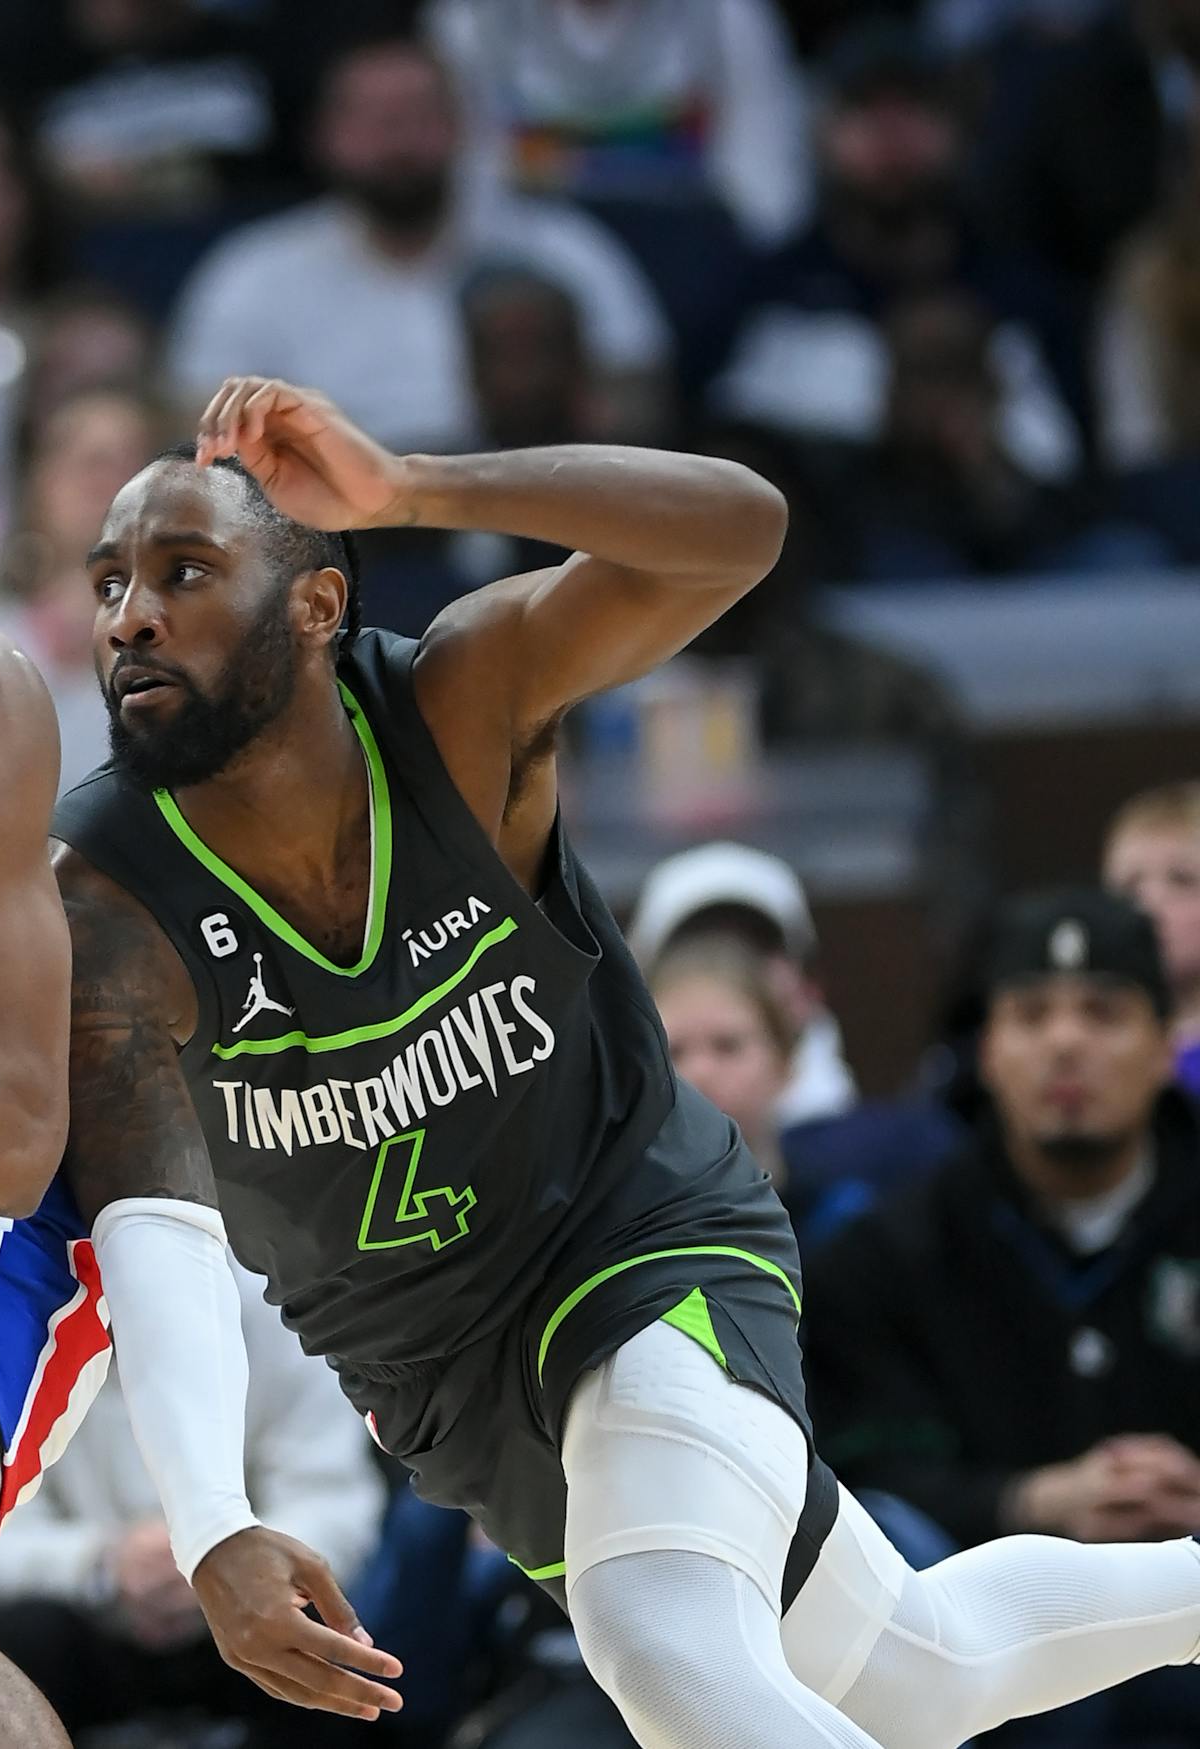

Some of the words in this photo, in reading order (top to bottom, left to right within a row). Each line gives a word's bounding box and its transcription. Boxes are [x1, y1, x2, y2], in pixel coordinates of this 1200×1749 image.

[200, 912, 238, 958] 6
[212, 975, 555, 1157] TIMBERWOLVES
[357, 1128, 478, 1252] 4
